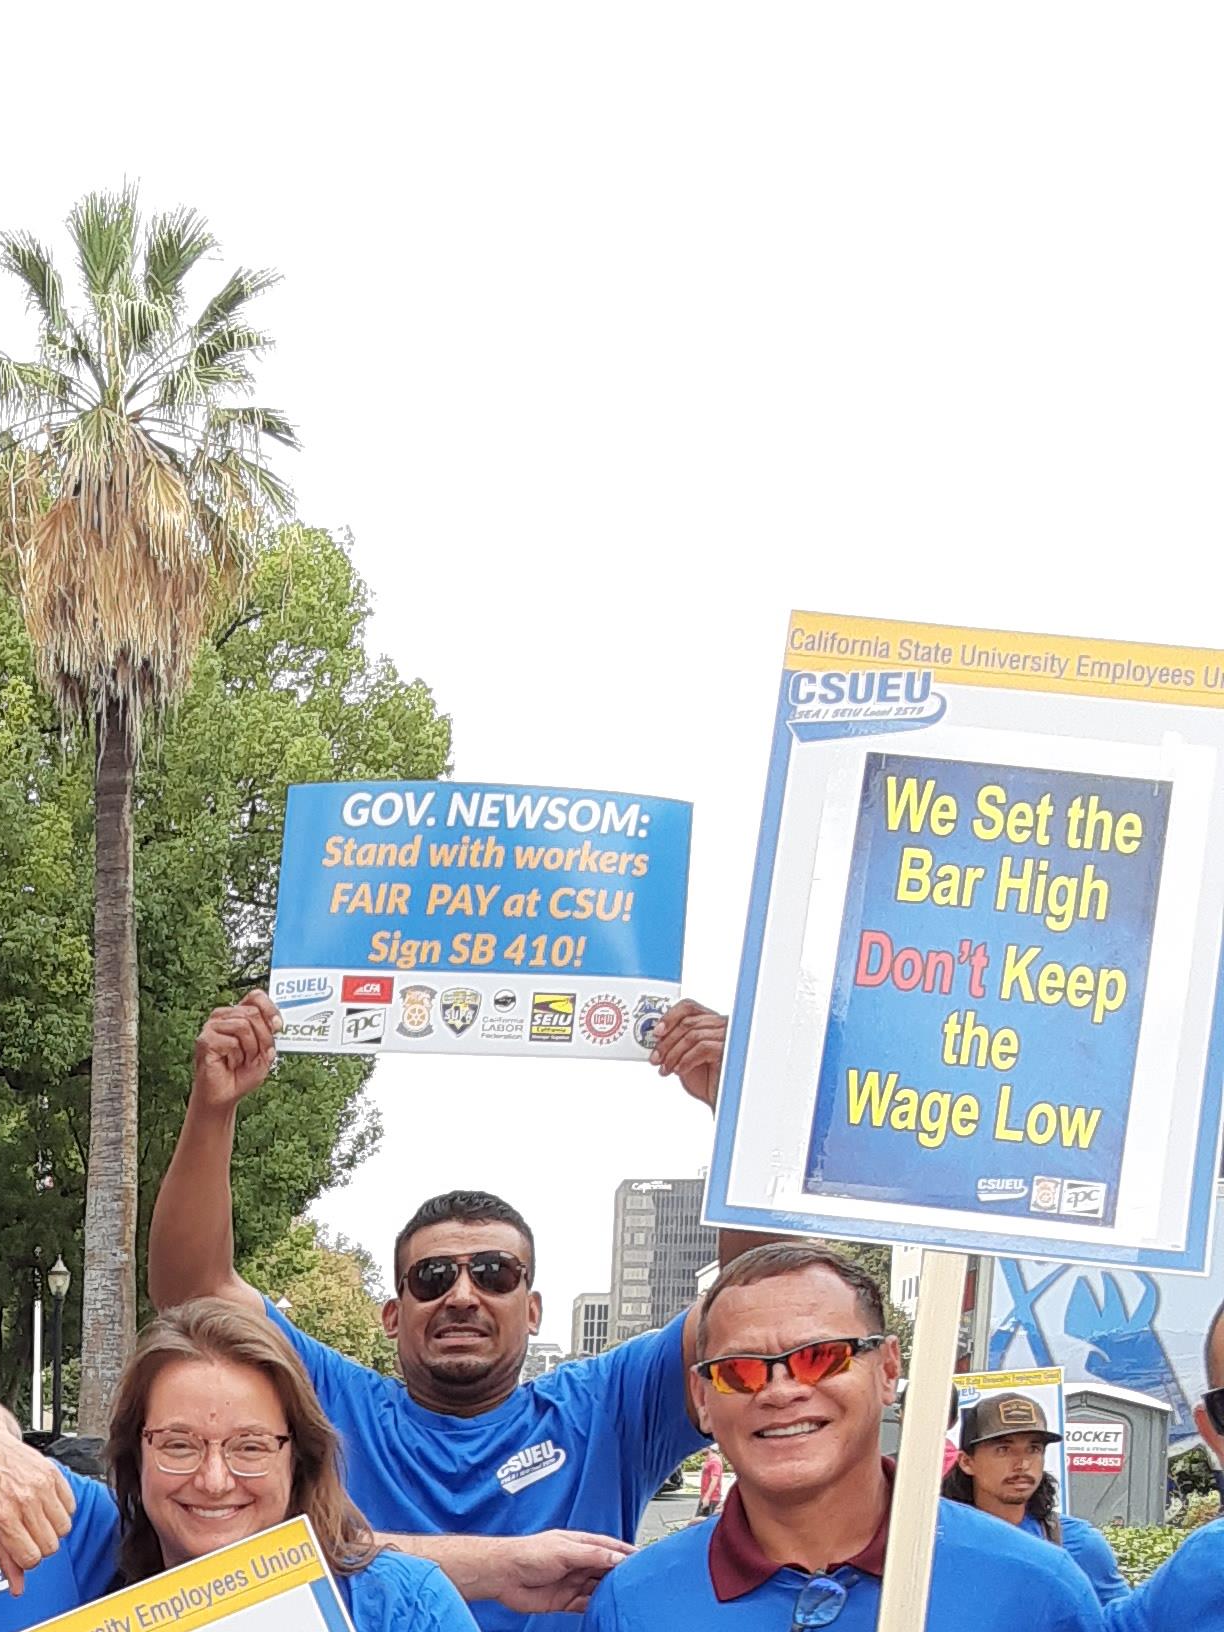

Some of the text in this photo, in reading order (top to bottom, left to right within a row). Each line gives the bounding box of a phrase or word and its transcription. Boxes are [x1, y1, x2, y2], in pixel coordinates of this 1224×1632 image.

[790, 628, 890, 659] California
[898, 638, 953, 663] State
[960, 644, 1069, 681] University
[1077, 655, 1195, 688] Employees
[791, 672, 931, 704] CSUEU
[342, 792, 651, 838] GOV. NEWSOM:
[885, 776, 1143, 854] We Set the
[322, 835, 648, 877] Stand with workers
[329, 883, 633, 922] FAIR PAY at CSU!
[896, 846, 1110, 932] Bar High
[368, 931, 586, 969] Sign SB 410!
[276, 977, 327, 995] CSUEU
[363, 984, 381, 993] CFA
[855, 930, 1127, 1023] Don't Keep
[280, 1024, 330, 1037] AFSCME
[347, 1014, 381, 1038] apc
[482, 1024, 523, 1032] LABOR
[532, 1013, 572, 1026] SEIU
[942, 1011, 1020, 1071] the
[847, 1069, 1102, 1149] Wage Low
[977, 1179, 1024, 1190] CSUEU
[1066, 1190, 1100, 1208] apc
[1065, 1431, 1122, 1442] ROCKET
[136, 1567, 249, 1630] Employees
[251, 1539, 314, 1581] Union
